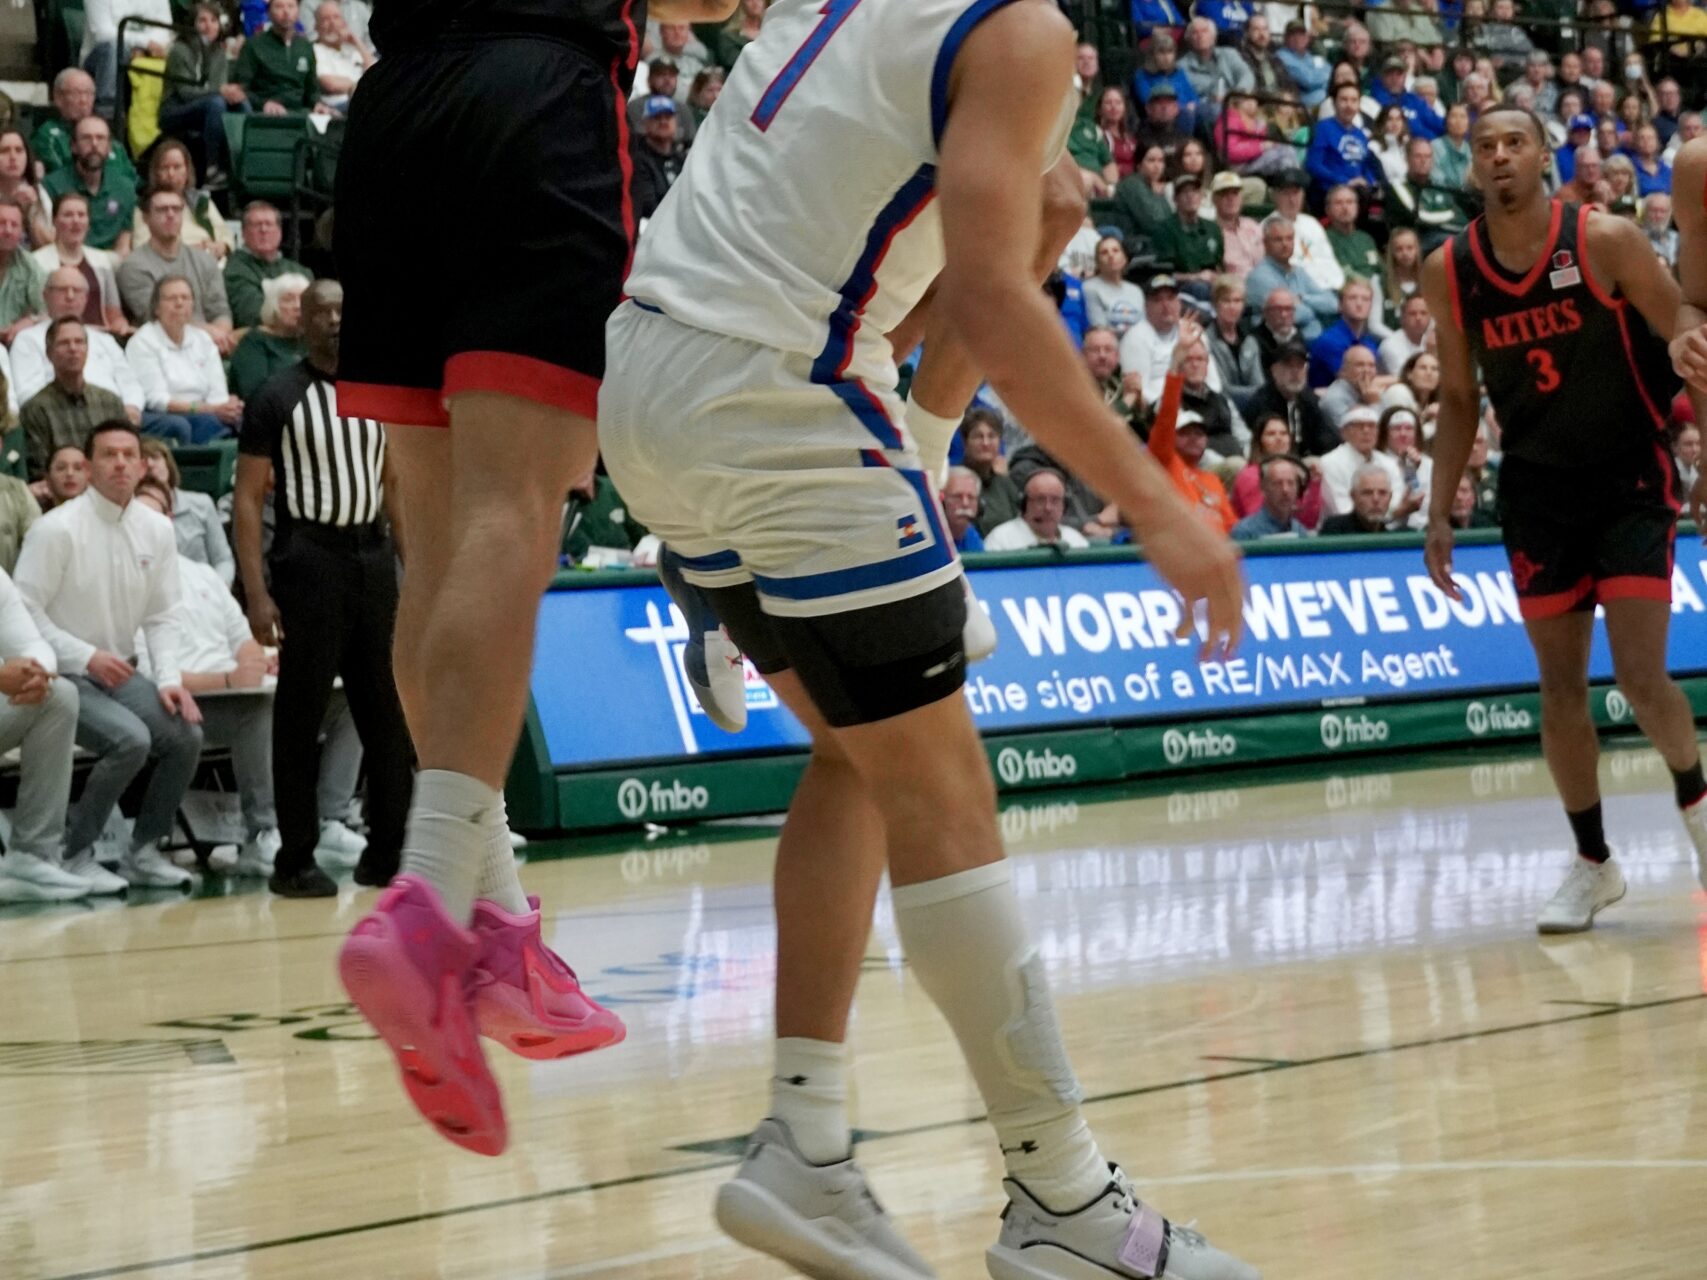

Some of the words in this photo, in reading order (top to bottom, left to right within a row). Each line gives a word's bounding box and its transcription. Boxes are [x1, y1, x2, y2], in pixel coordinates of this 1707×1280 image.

[1482, 297, 1583, 350] AZTECS
[1526, 347, 1562, 394] 3
[1242, 579, 1409, 642] WE'VE
[1406, 570, 1523, 630] DON
[963, 676, 1029, 715] the
[1036, 670, 1117, 714] sign
[1123, 662, 1162, 702] of
[1171, 670, 1195, 699] a
[1199, 651, 1353, 697] RE/MAX
[1361, 644, 1460, 687] Agent
[1344, 715, 1389, 743] fnbo
[1488, 703, 1533, 730] fnbo
[1187, 729, 1237, 758] fnbo
[1024, 748, 1077, 780] fnbo
[649, 780, 709, 812] fnbo
